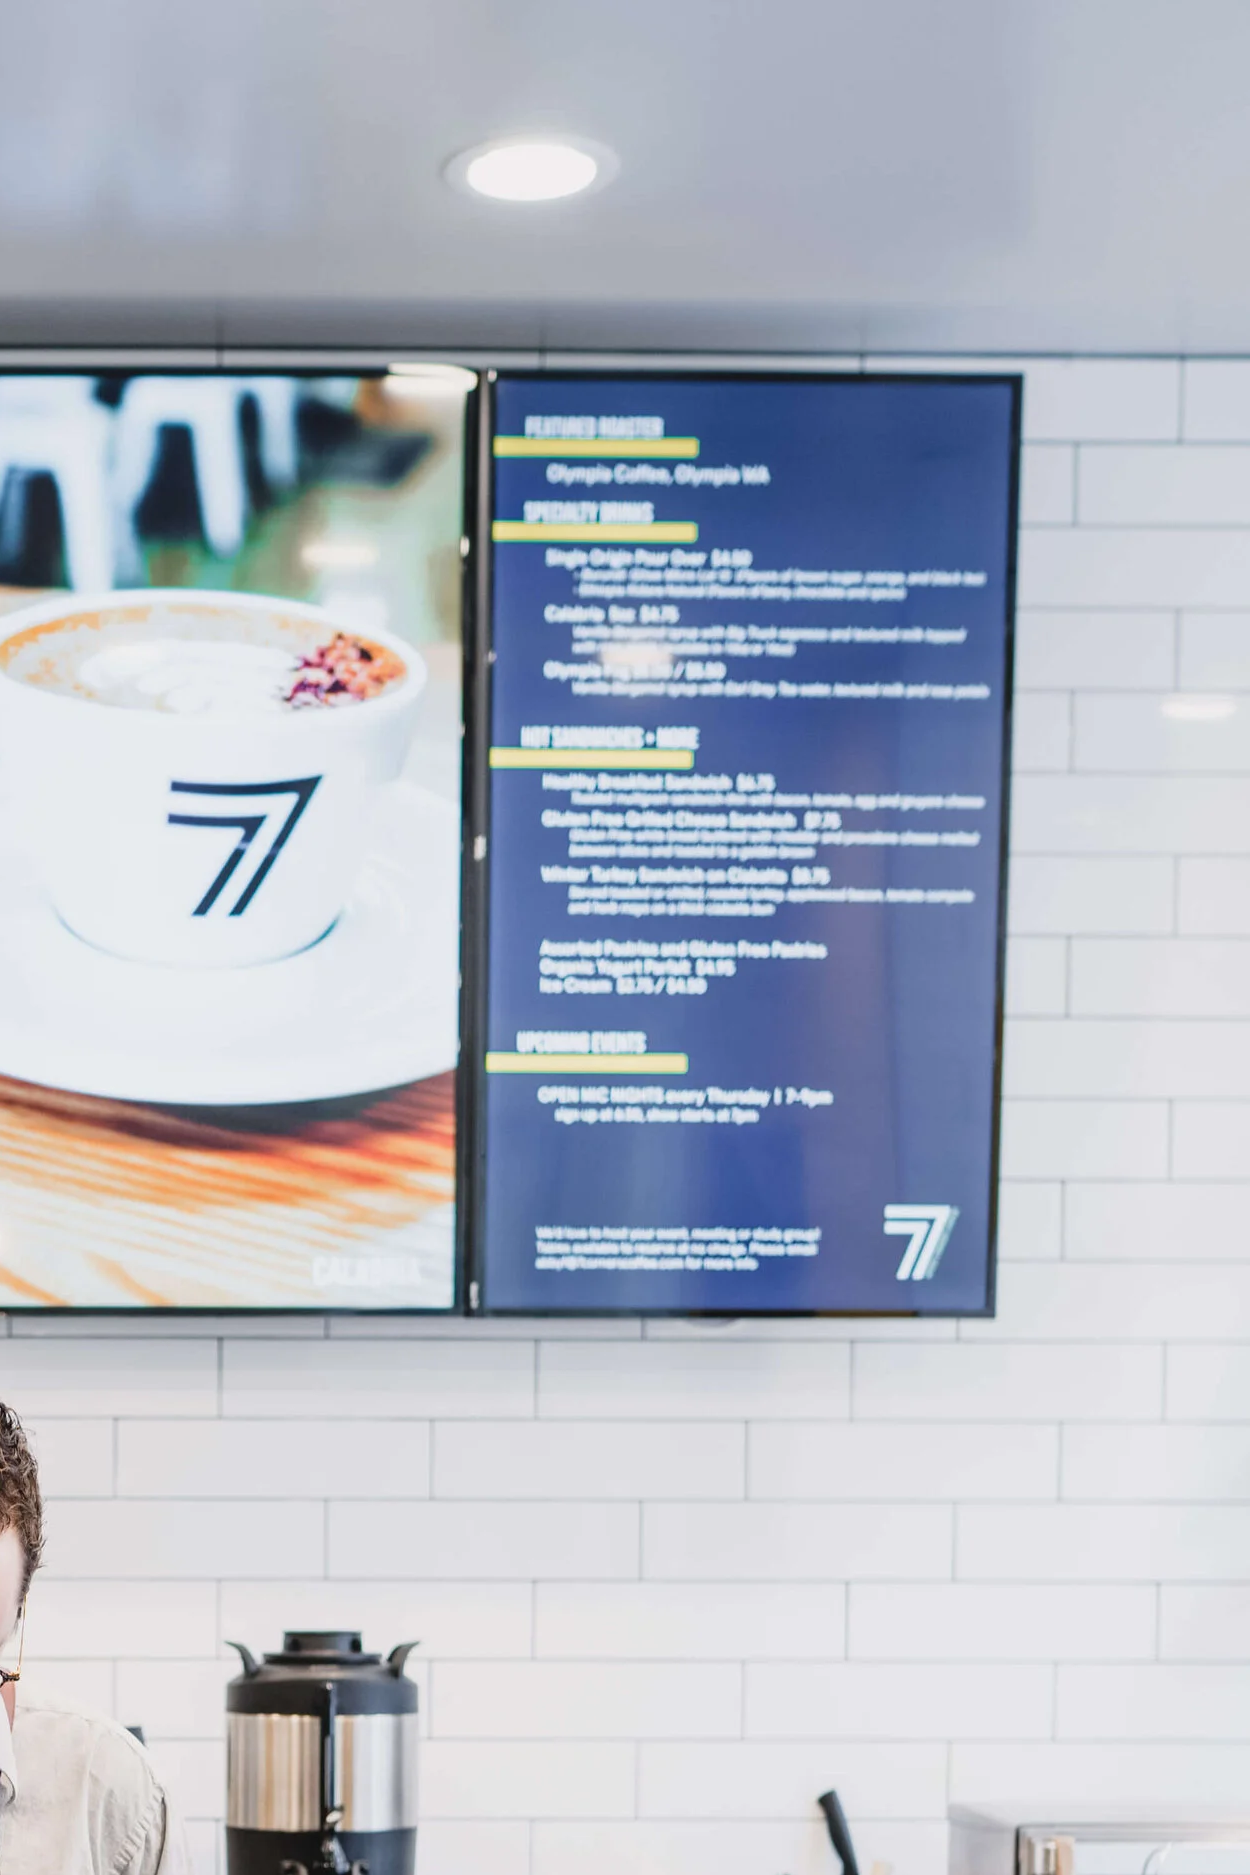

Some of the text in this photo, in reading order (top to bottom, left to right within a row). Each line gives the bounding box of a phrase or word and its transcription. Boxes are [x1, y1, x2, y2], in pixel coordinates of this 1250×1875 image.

[167, 773, 325, 918] 7
[517, 1032, 646, 1052] UPCOMING EVENTS
[883, 1203, 960, 1281] 7
